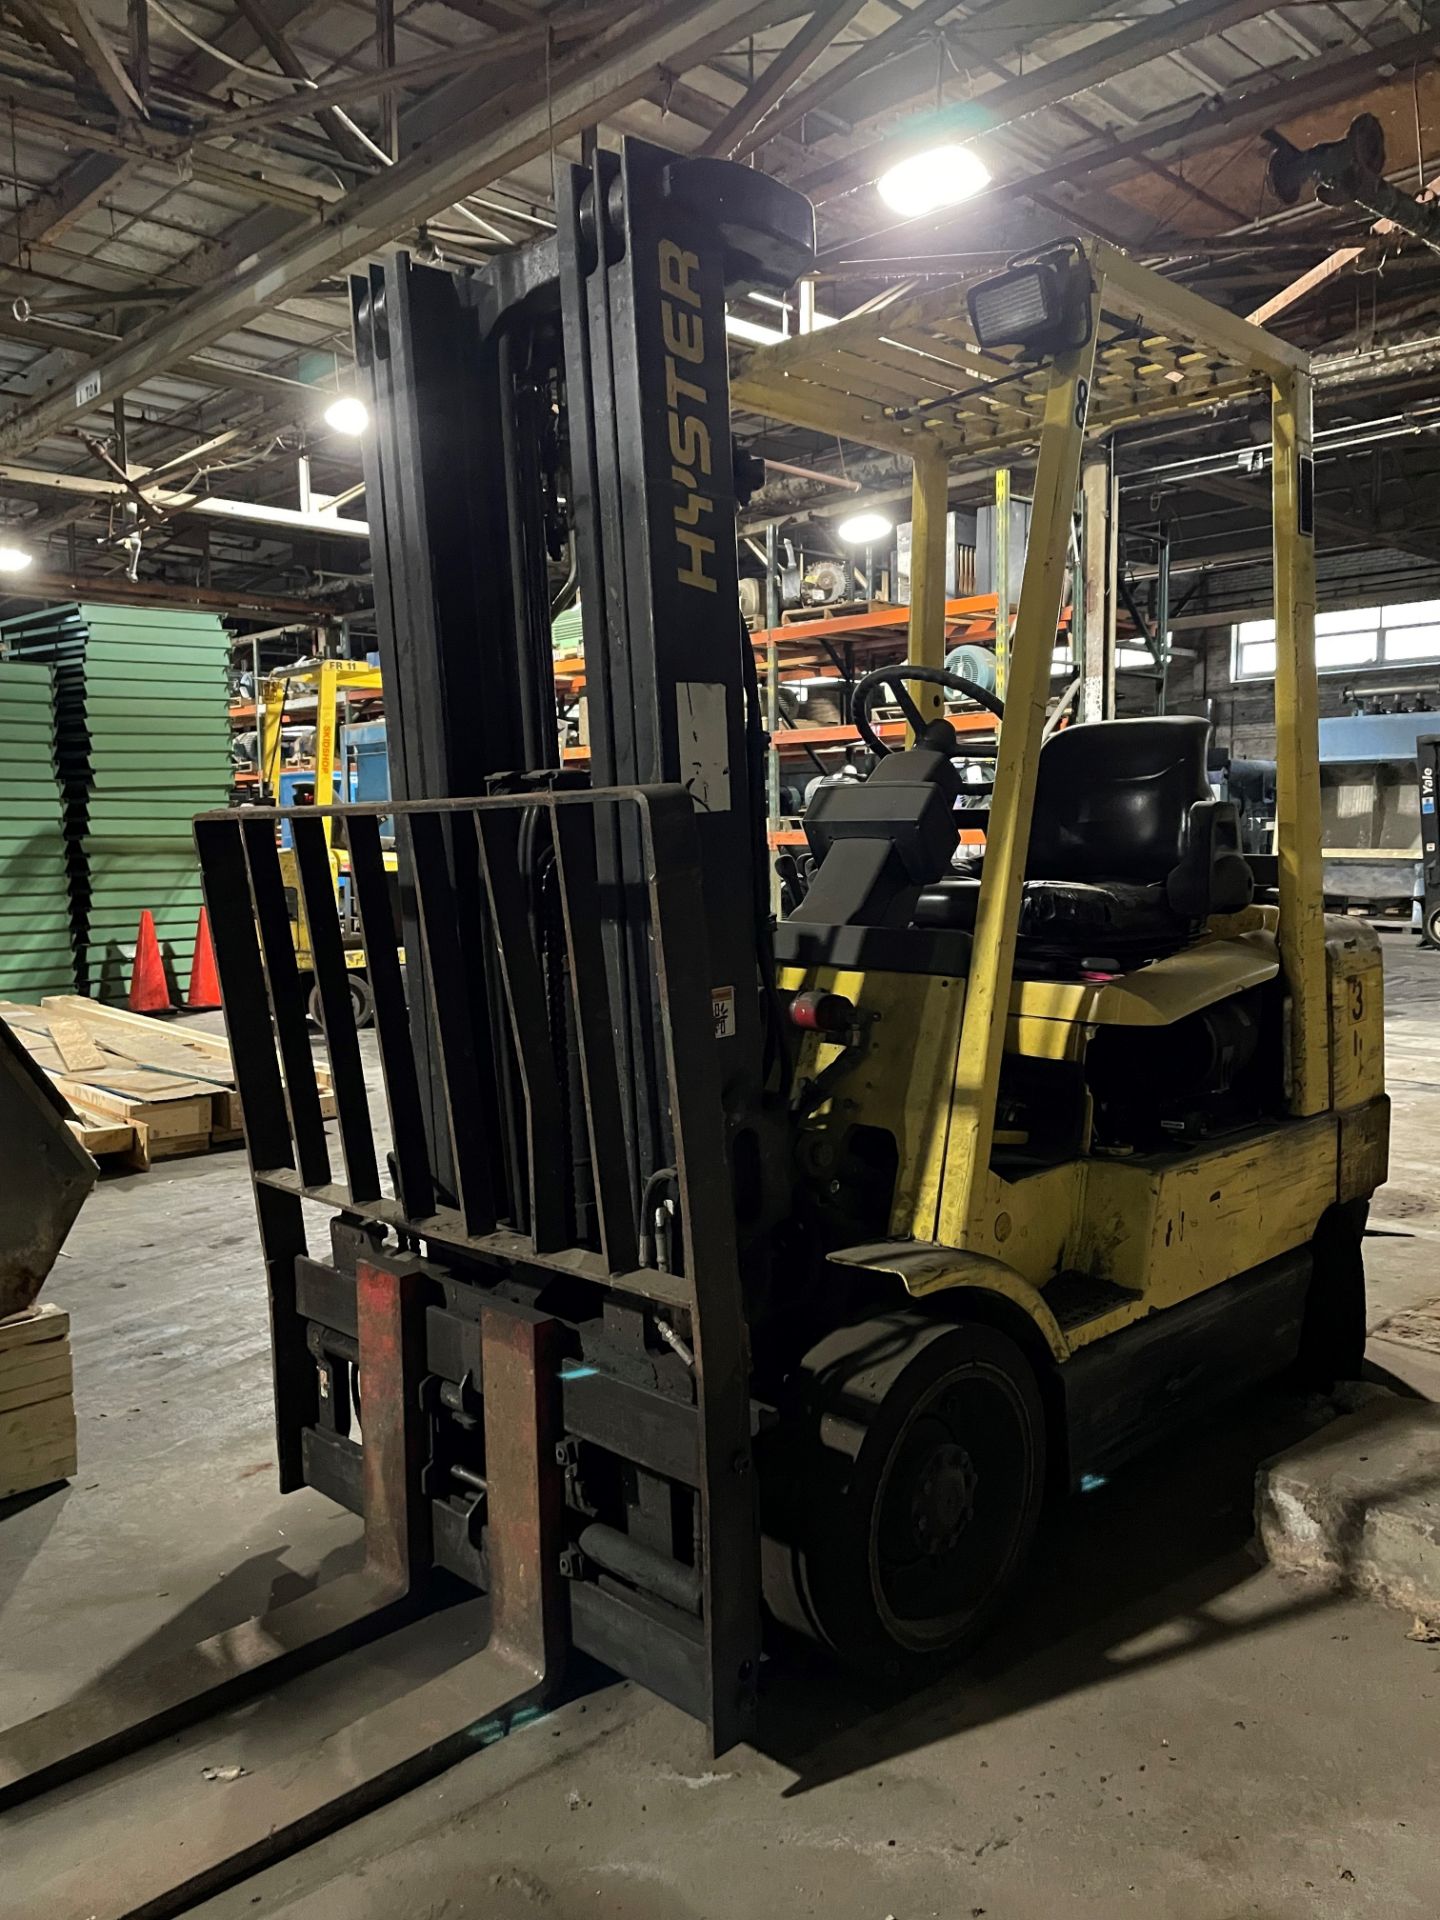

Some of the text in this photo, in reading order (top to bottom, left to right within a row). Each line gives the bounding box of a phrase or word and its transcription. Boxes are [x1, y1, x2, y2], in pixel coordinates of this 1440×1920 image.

[657, 238, 718, 593] HYSTER
[347, 662, 356, 670] 11
[321, 726, 331, 774] SKIDSHOP
[1421, 767, 1433, 795] Yale
